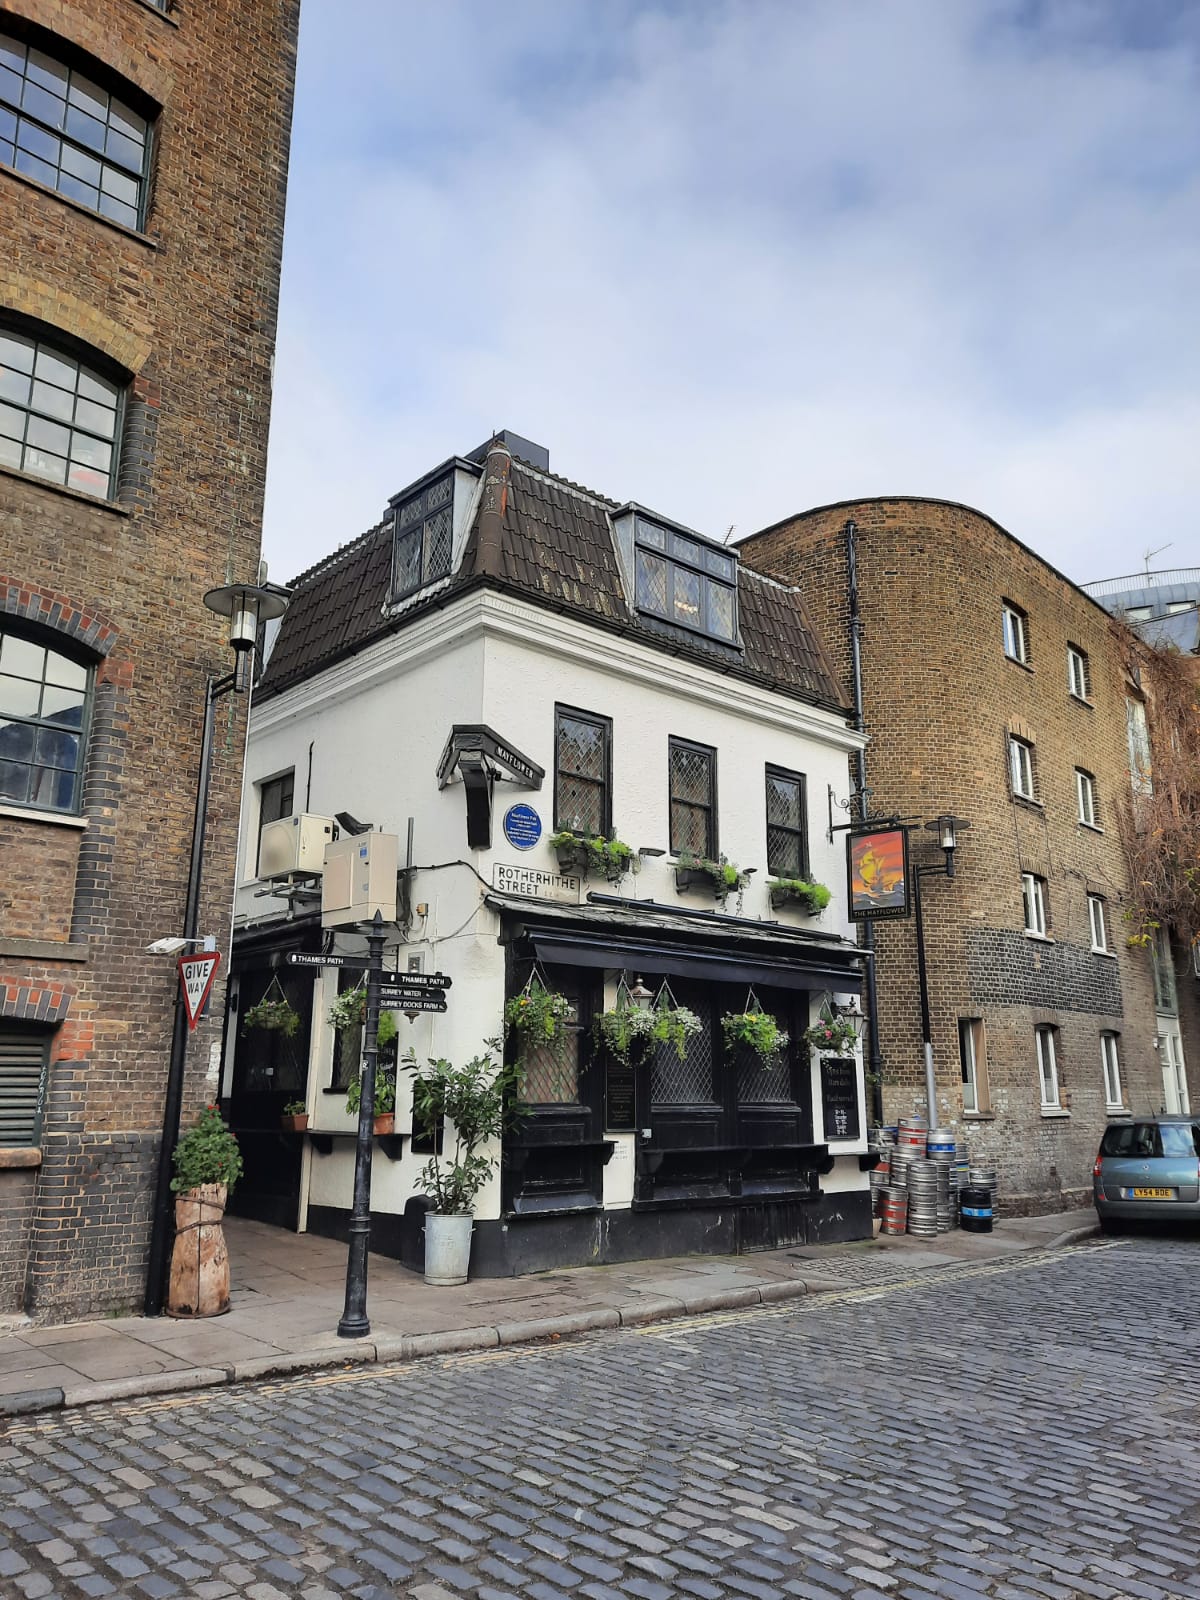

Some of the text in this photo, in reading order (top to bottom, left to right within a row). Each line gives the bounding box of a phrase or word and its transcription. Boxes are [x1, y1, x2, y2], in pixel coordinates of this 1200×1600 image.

[498, 866, 576, 889] ROTHERHITHE
[498, 880, 539, 895] STREET
[298, 955, 344, 964] THAMES PATH
[185, 962, 209, 980] GIVE
[402, 975, 428, 984] THAMES
[187, 982, 205, 994] WAY
[380, 987, 422, 997] SURREY WATER
[380, 1000, 439, 1010] SURREY DOCKS FARM
